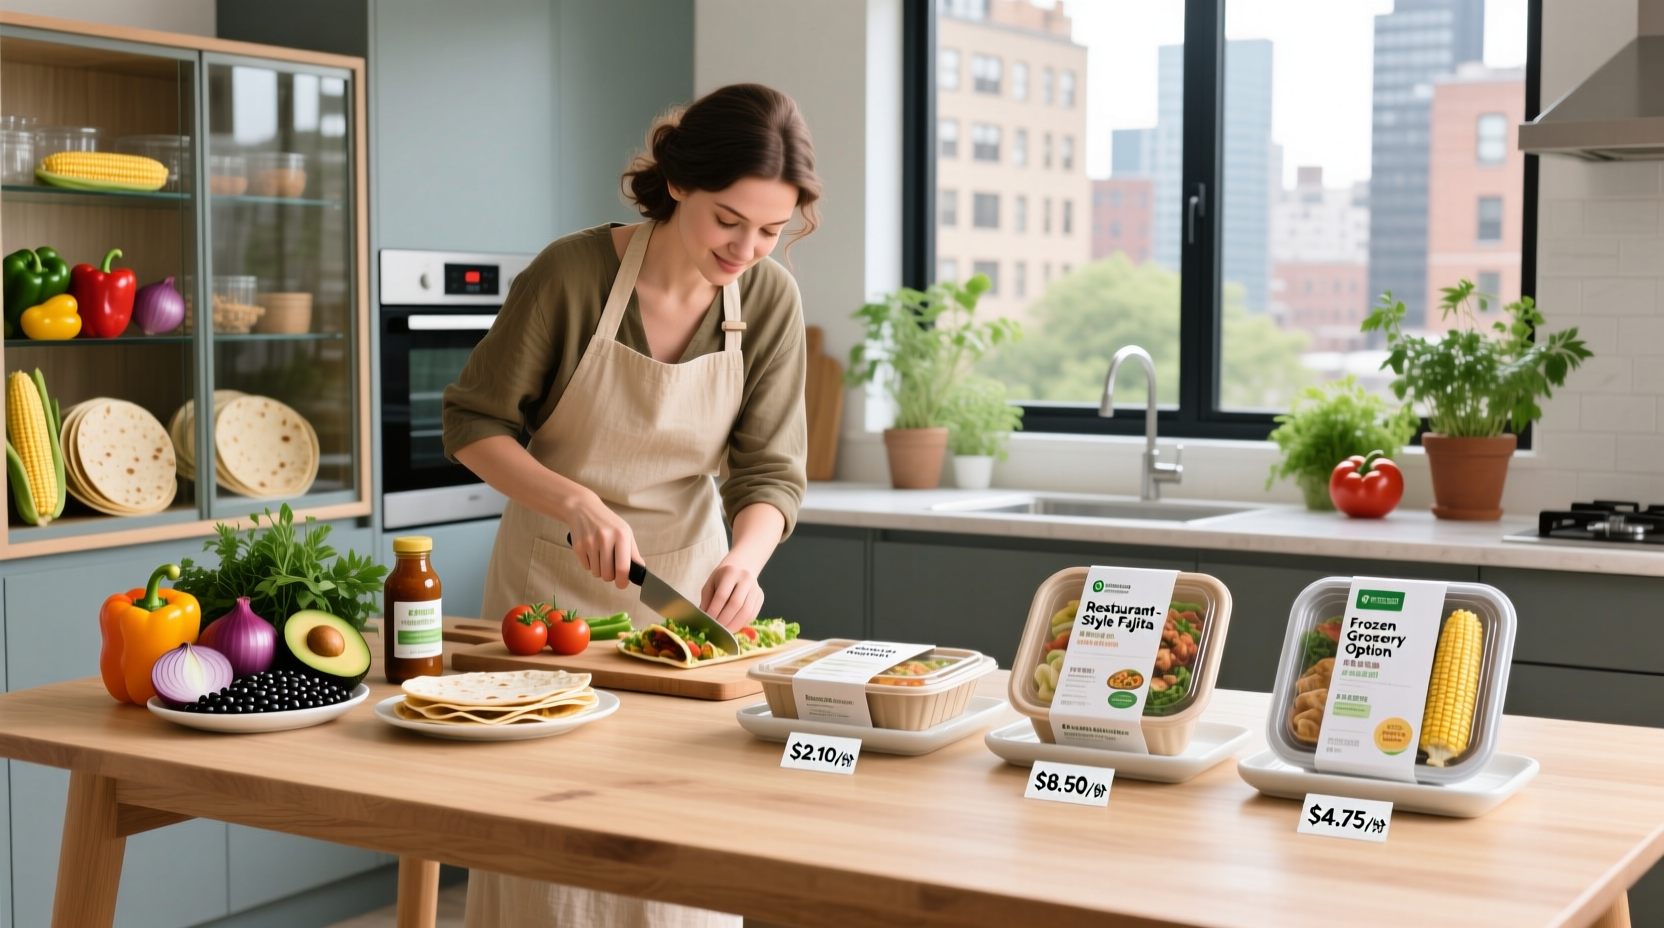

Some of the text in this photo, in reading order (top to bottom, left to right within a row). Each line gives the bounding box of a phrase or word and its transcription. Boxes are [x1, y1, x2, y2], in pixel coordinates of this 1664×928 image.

[1081, 615, 1154, 633] Style Fajita
[1350, 617, 1396, 631] Frozen
[1345, 643, 1392, 658] Option
